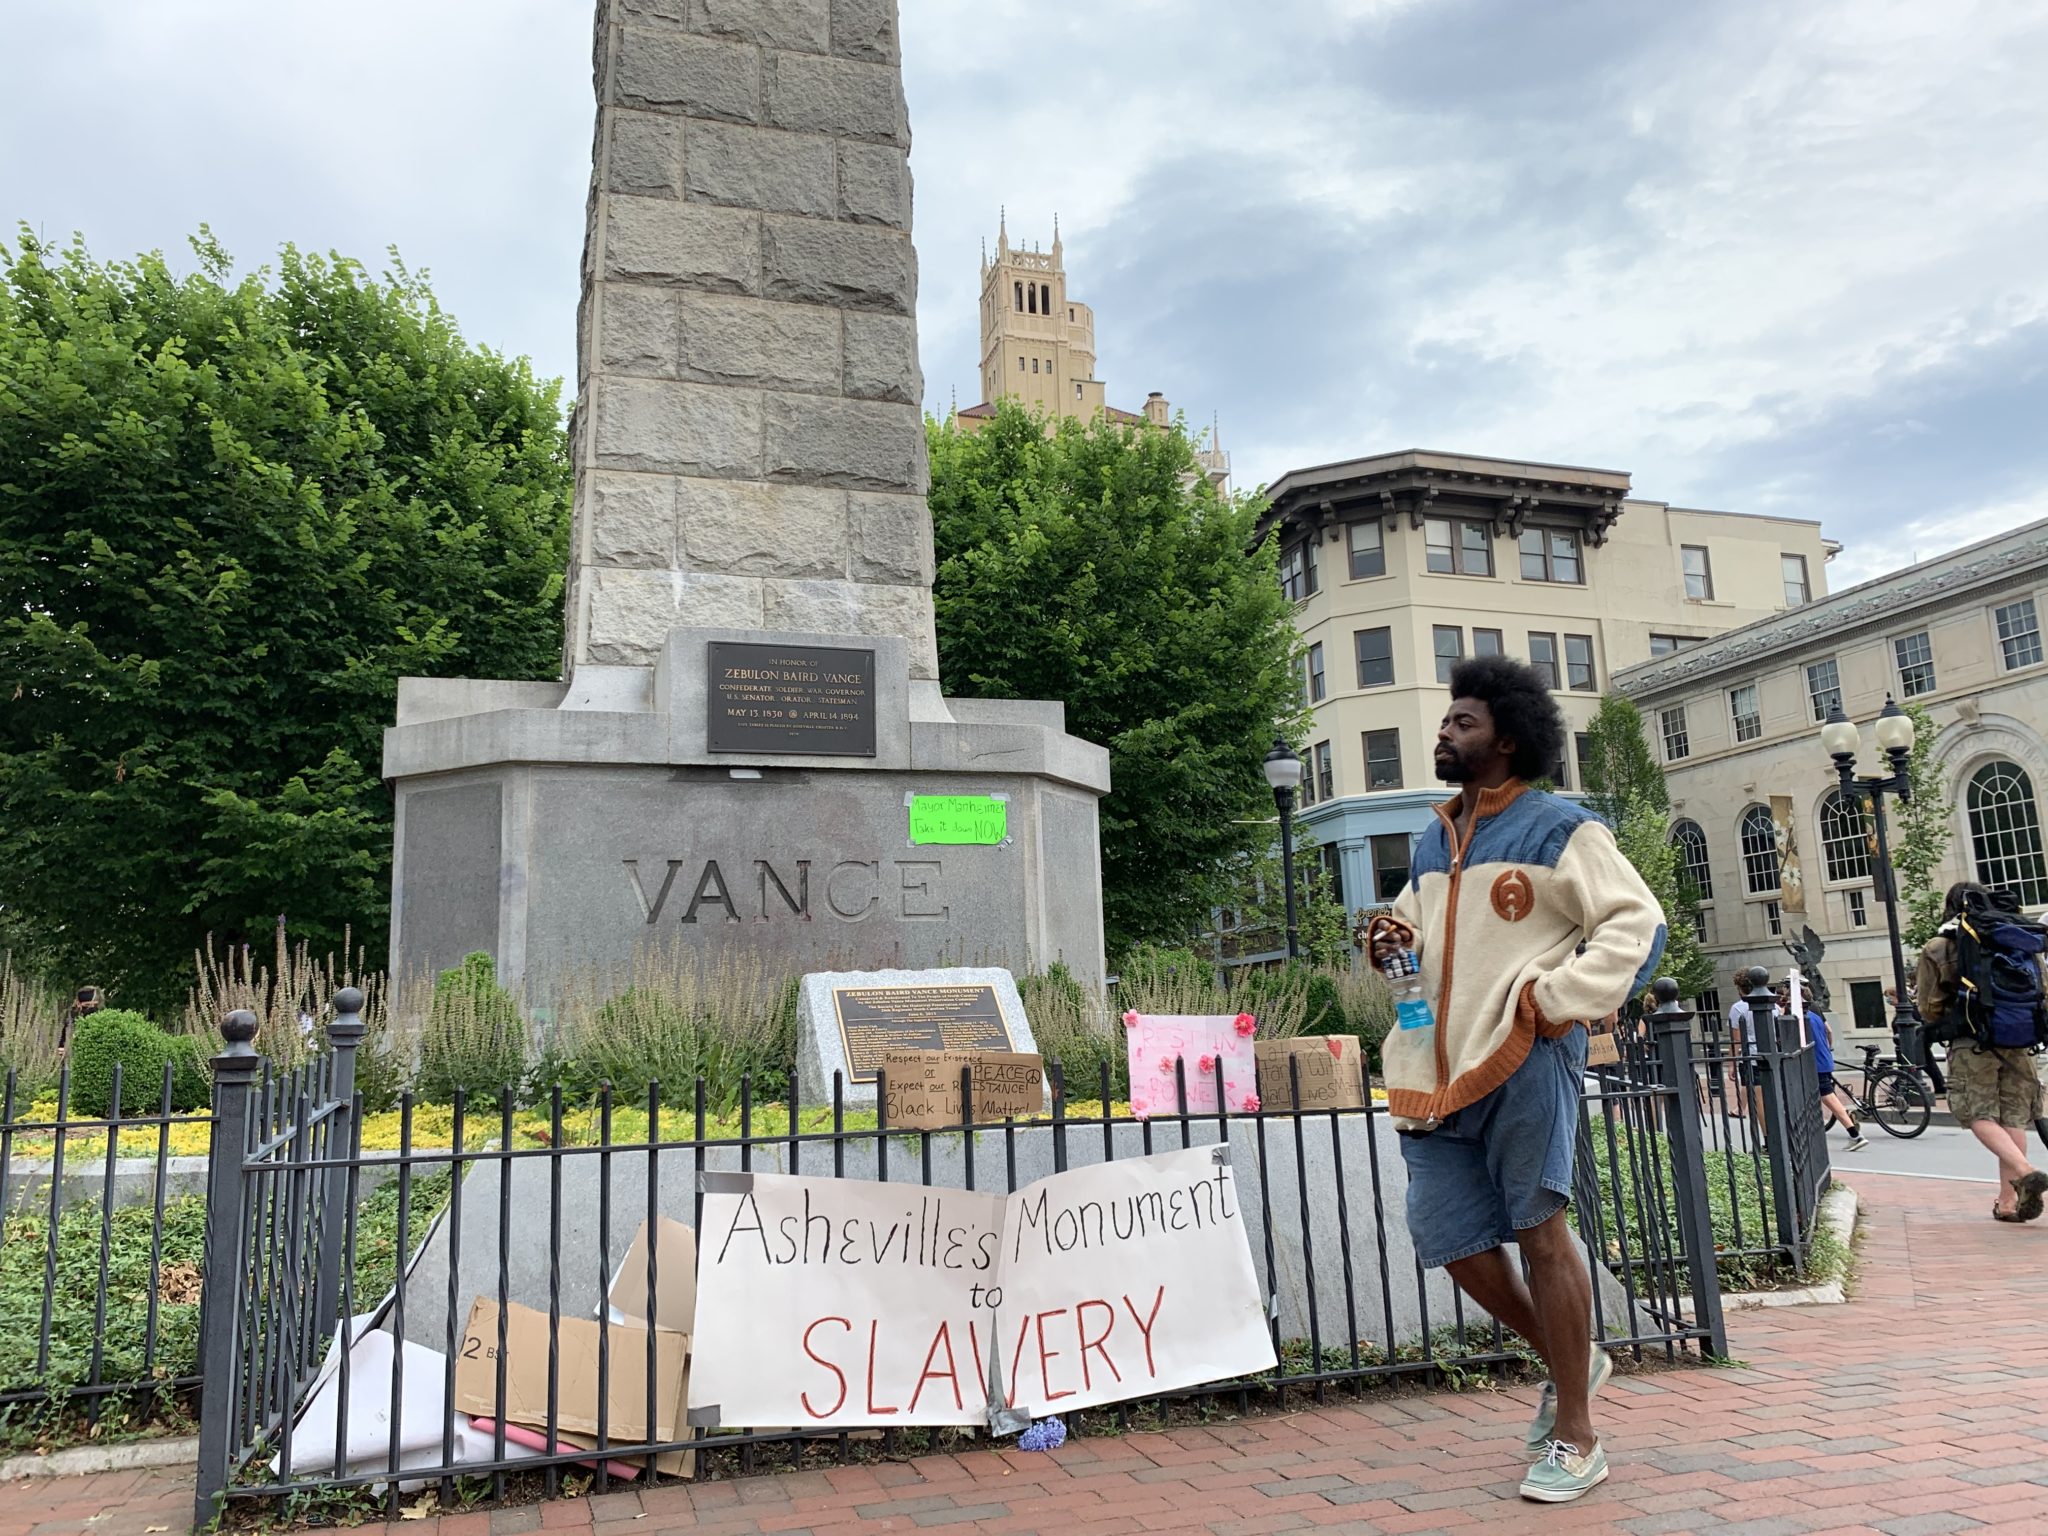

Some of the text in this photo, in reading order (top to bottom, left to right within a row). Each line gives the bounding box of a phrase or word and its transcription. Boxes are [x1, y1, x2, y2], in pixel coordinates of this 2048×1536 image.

[780, 659, 807, 667] HONOR
[724, 668, 863, 684] ZEBULON BAIRD VANCE
[719, 684, 772, 692] CONFEDERATE
[825, 688, 866, 697] GOVERNOR
[727, 708, 747, 717] MAY
[763, 710, 784, 719] 1830
[803, 711, 828, 720] APRIL
[840, 713, 860, 721] 1894
[913, 799, 944, 813] Mayor
[913, 818, 1006, 841] Take it down NOW
[622, 860, 950, 924] VANCE
[886, 1053, 921, 1066] Respect
[925, 1068, 935, 1077] or
[974, 1065, 1026, 1081] PEACE
[889, 1081, 1029, 1095] Expect our RISTANCE!
[885, 1092, 1030, 1119] Black Livs Matter!
[718, 1167, 1234, 1271] Asheville's Monument
[969, 1283, 1003, 1310] to
[800, 1286, 1165, 1419] SLAVERY
